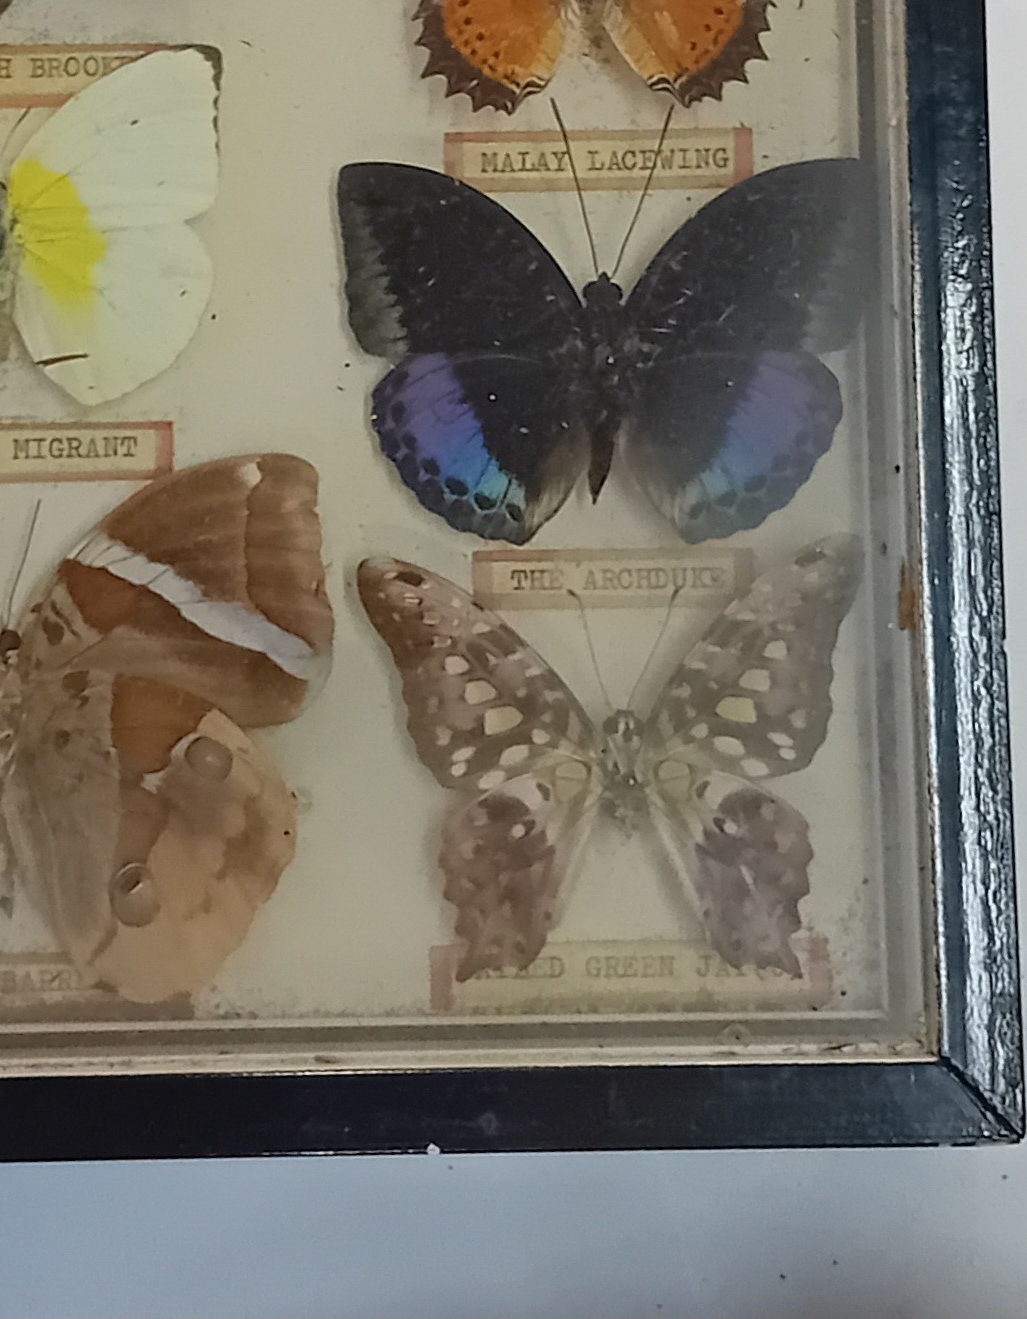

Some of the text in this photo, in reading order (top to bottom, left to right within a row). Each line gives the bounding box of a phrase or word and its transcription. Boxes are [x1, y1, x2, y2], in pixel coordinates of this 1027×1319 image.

[480, 147, 729, 173] MALAY LACEWING
[12, 436, 138, 460] MIGRANT
[510, 566, 726, 591] THE ARCHDUKE
[585, 955, 674, 979] GREEN
